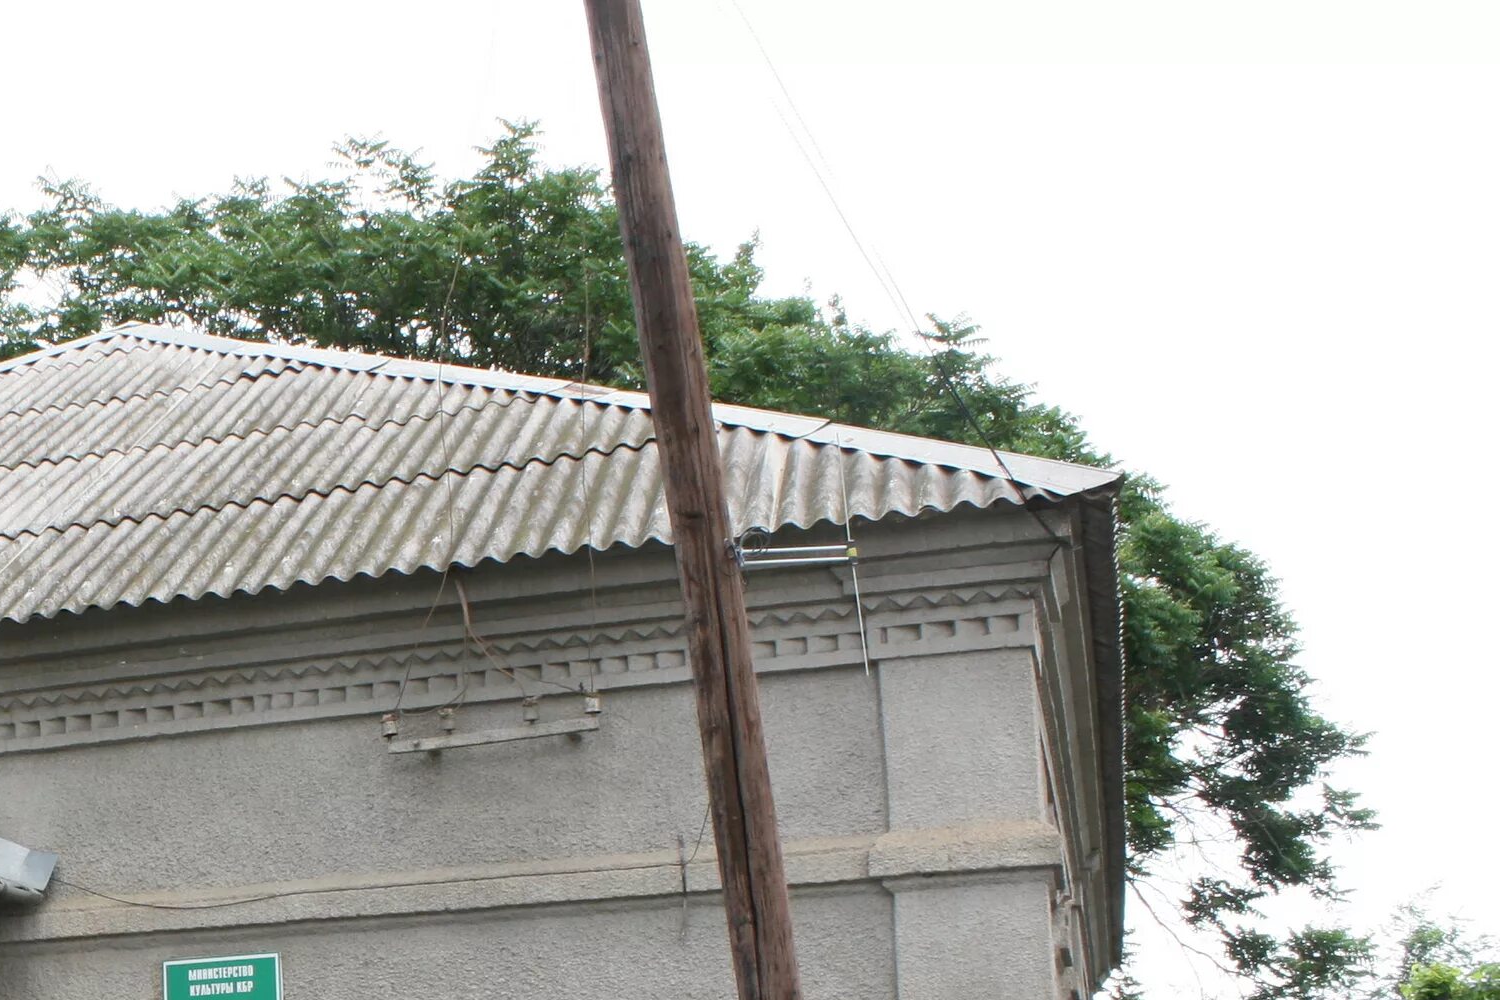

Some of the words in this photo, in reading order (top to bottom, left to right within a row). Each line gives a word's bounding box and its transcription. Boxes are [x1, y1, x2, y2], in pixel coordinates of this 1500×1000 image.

[188, 965, 253, 981] МИНИСТЕРСТВО
[190, 982, 233, 996] КУЛЬТУРЫ
[236, 981, 253, 993] КБР
